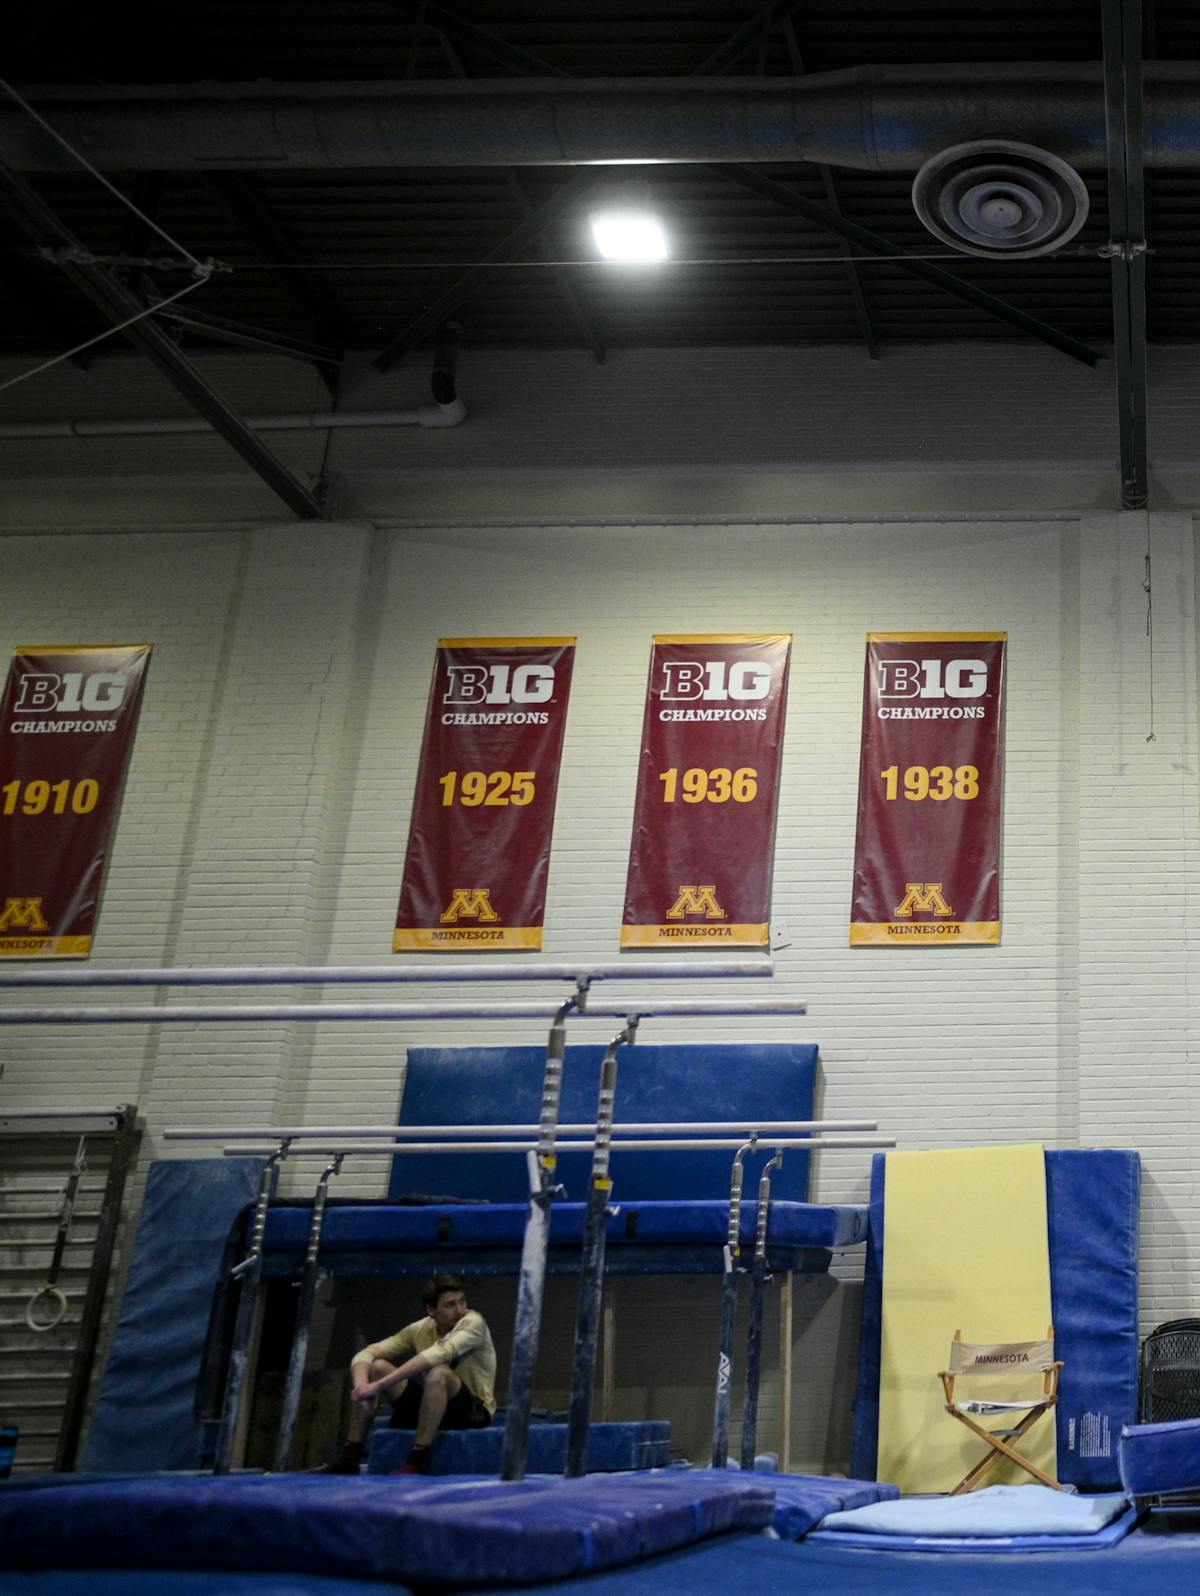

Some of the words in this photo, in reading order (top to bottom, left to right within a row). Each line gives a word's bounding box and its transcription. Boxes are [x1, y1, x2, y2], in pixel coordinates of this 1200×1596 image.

[441, 711, 549, 726] CHAMPIONS
[658, 708, 767, 722] CHAMPIONS
[877, 706, 986, 720] CHAMPIONS
[10, 719, 117, 734] CHAMPIONS
[439, 771, 536, 807] 1925
[658, 767, 758, 803] 1936
[880, 765, 979, 801] 1938
[2, 779, 100, 815] 1910
[440, 888, 498, 923] M
[665, 885, 724, 919] M
[894, 883, 952, 917] M
[431, 931, 505, 941] MINNESOTA
[658, 928, 733, 937] MINNESOTA
[887, 925, 961, 935] MINNESOTA
[974, 1352, 1029, 1364] MINNESOTA
